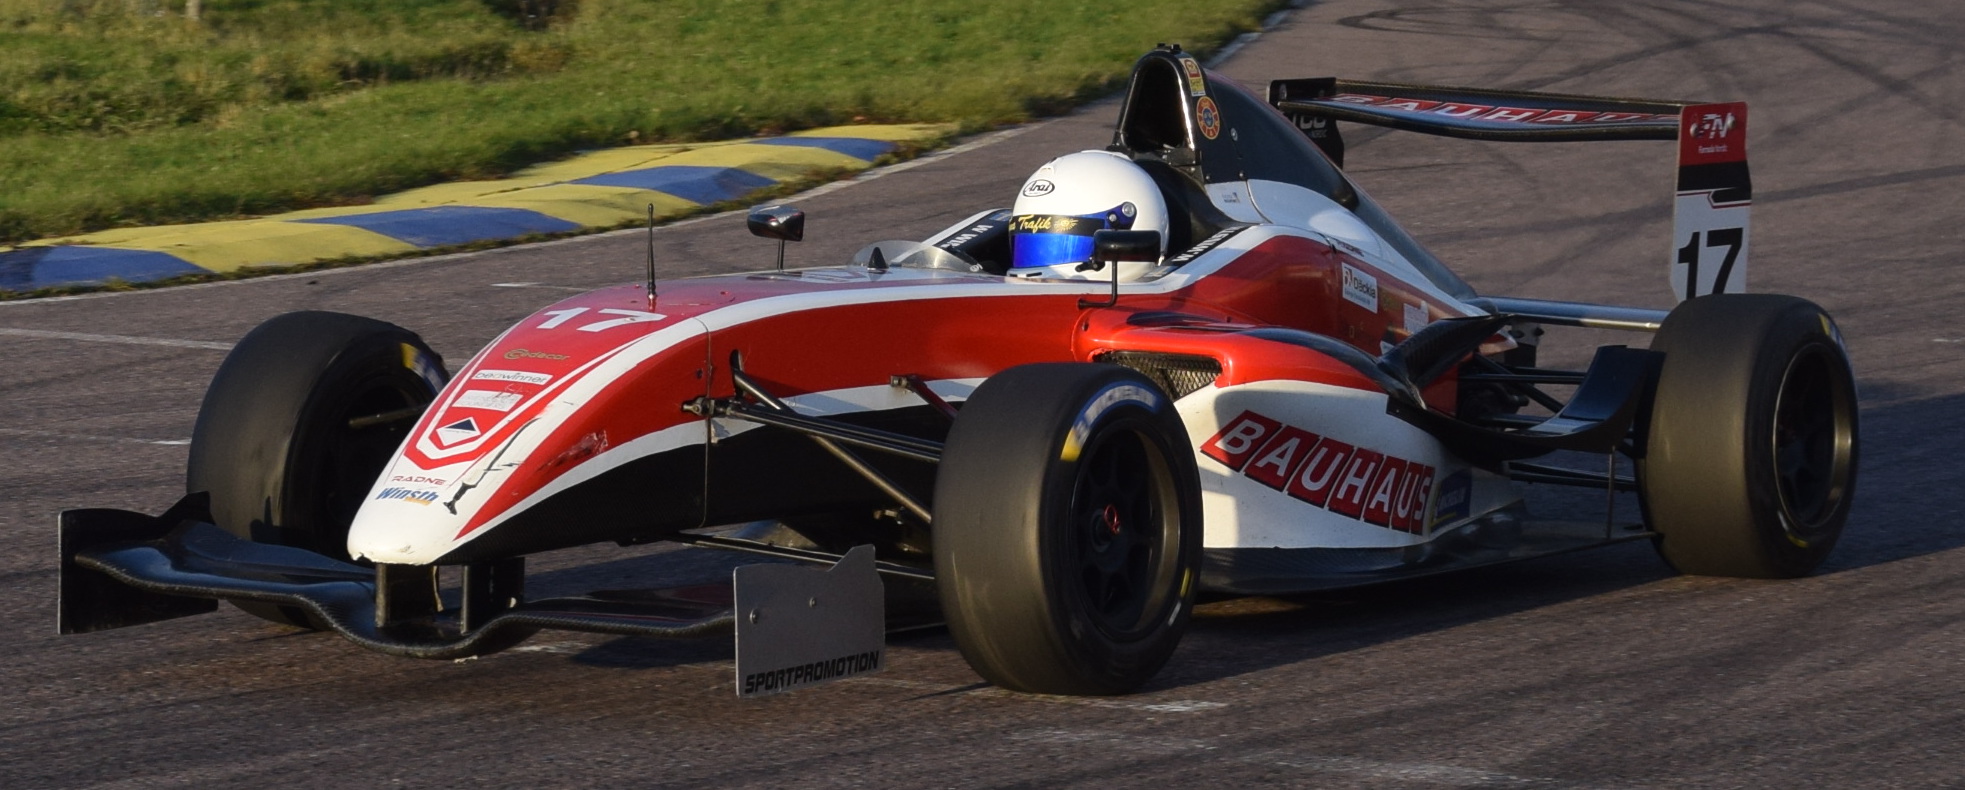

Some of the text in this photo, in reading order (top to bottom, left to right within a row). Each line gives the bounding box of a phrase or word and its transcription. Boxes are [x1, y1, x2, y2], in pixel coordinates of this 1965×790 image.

[1018, 214, 1052, 234] Trafik
[1678, 227, 1743, 300] 17
[536, 306, 668, 333] 17
[391, 475, 447, 486] RADNE
[1213, 418, 1431, 521] BAUHAUS
[744, 651, 880, 694] SPORTPROMOTION
